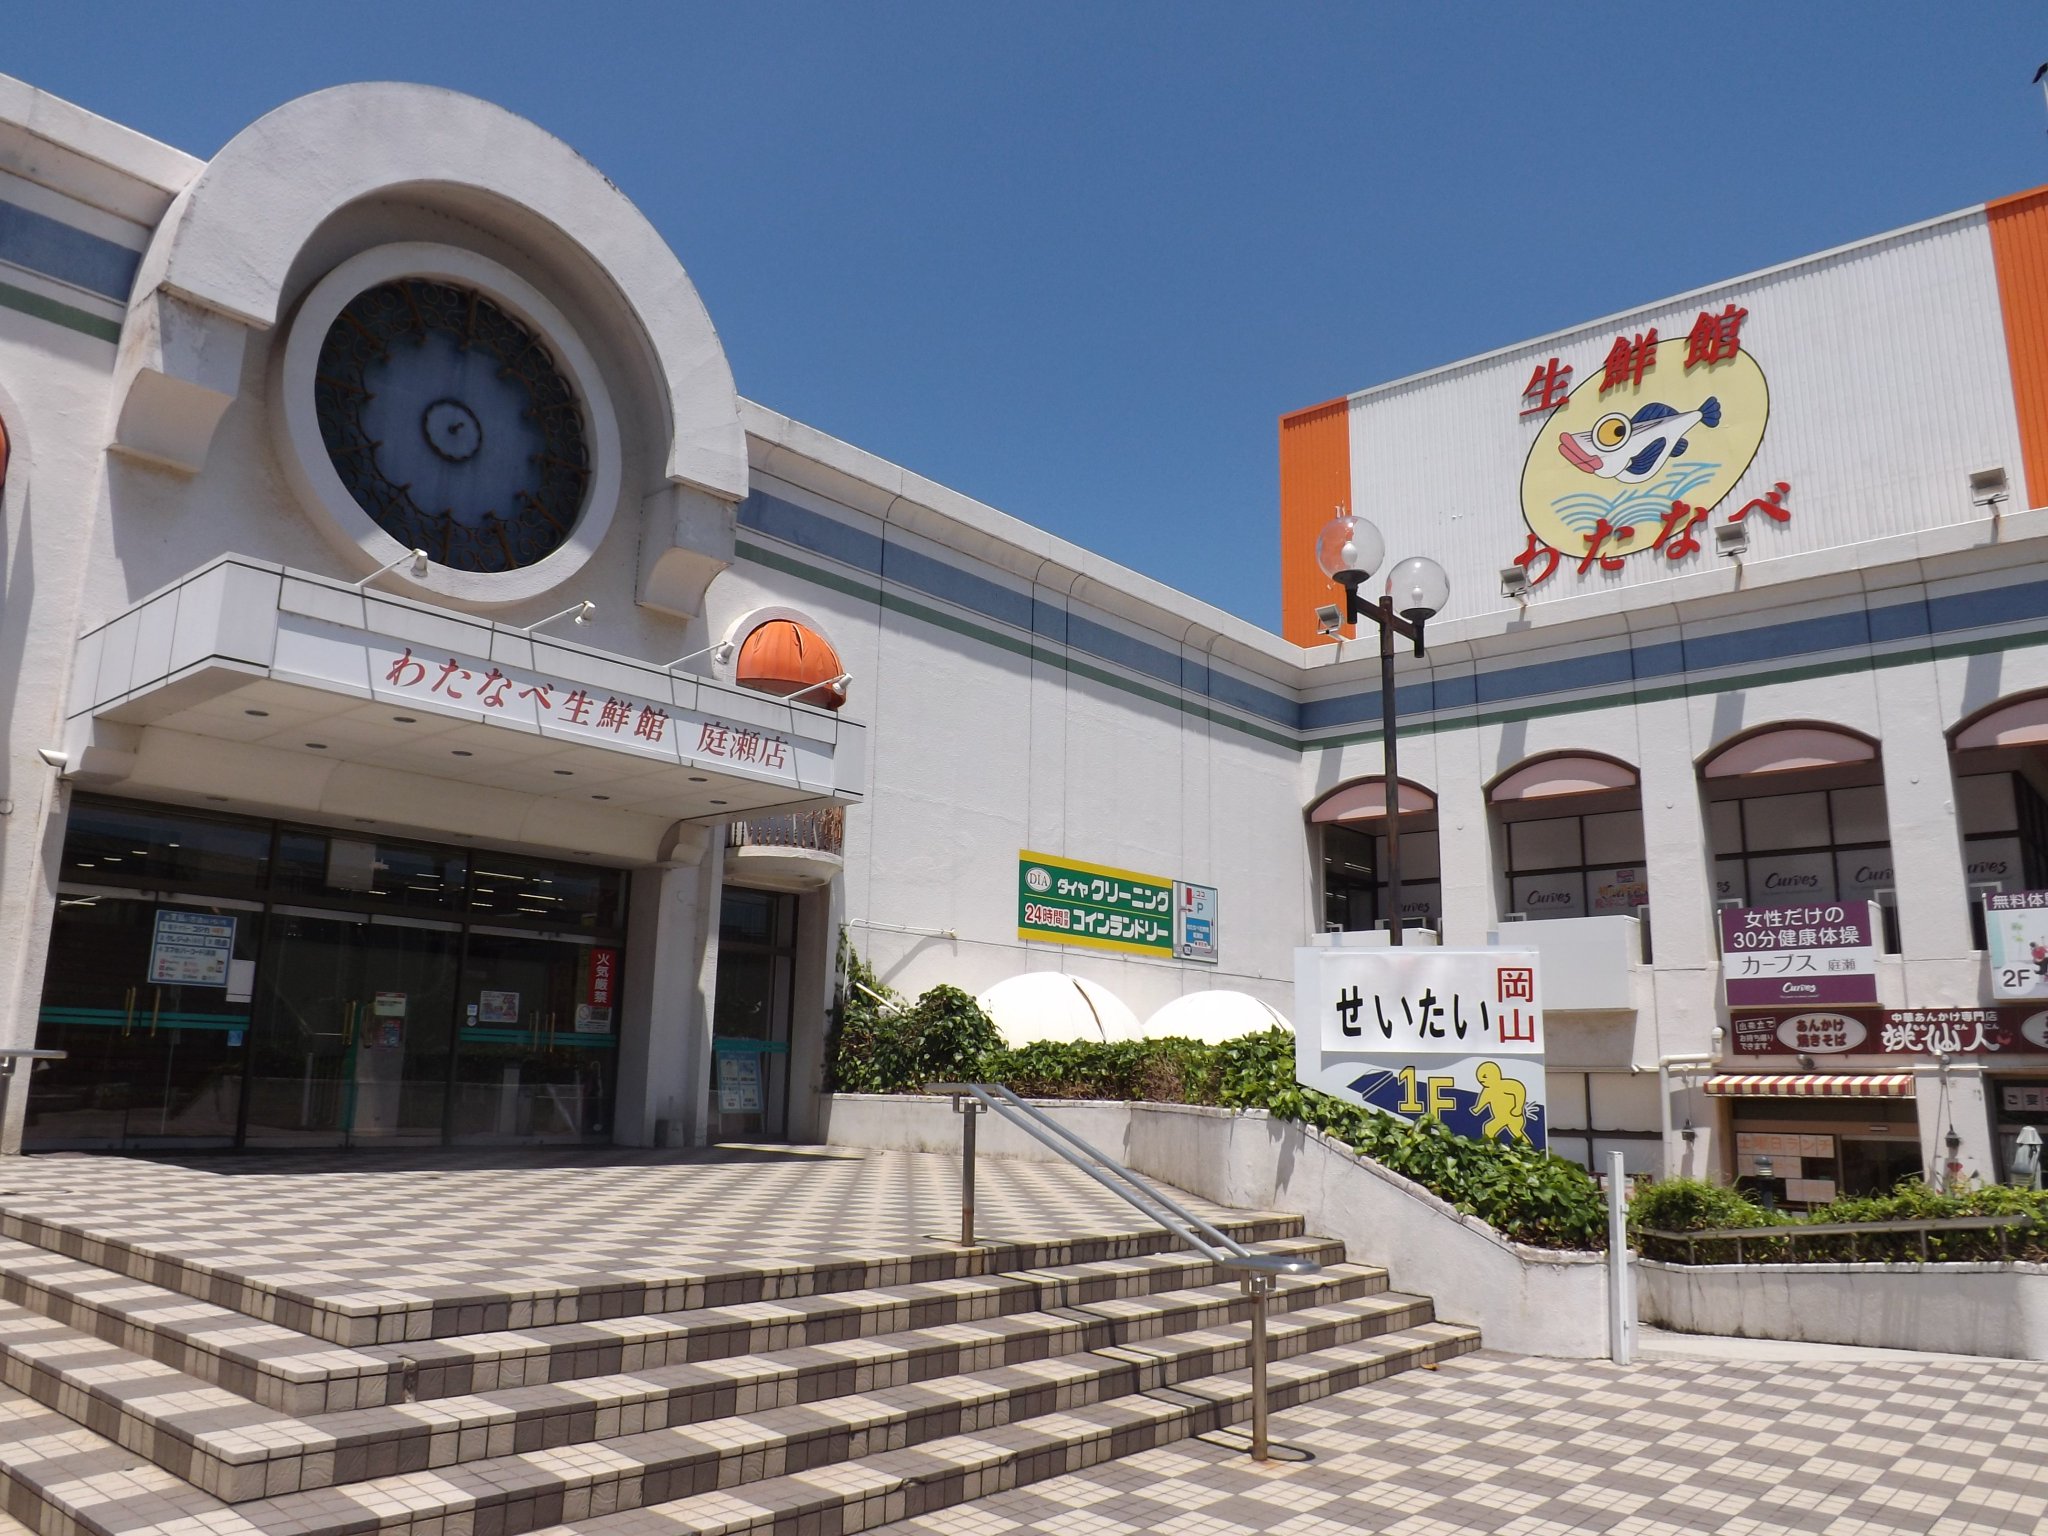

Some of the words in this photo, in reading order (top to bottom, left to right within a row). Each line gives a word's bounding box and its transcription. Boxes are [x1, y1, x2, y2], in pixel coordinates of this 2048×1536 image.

[1519, 304, 1749, 417] 生鮮館
[1513, 482, 1791, 587] わたなべ
[385, 647, 670, 744] わたなべ生鮮館
[696, 720, 789, 770] 庭瀬店
[1765, 871, 1818, 889] Curves
[1855, 866, 1893, 883] Curv
[1527, 890, 1572, 906] Curves
[1992, 892, 2048, 910] 無料体
[1073, 909, 1169, 942] コインランドリー
[1744, 906, 1845, 928] 女性だけの
[1733, 926, 1860, 948] 30分健康体操
[1742, 954, 1817, 975] カーブス
[1828, 958, 1856, 972] 庭瀬
[593, 952, 611, 1004] 火気厳禁
[1782, 982, 1817, 993] Curves
[2003, 968, 2030, 988] 2F
[1336, 985, 1489, 1040] せいたい
[1497, 967, 1535, 1043] 岡山
[1796, 1018, 1845, 1032] あんかけ
[1891, 1011, 1998, 1023] 中華あんかけ専門店
[1796, 1033, 1847, 1048] 焼きそば
[1397, 1065, 1456, 1121] 1F
